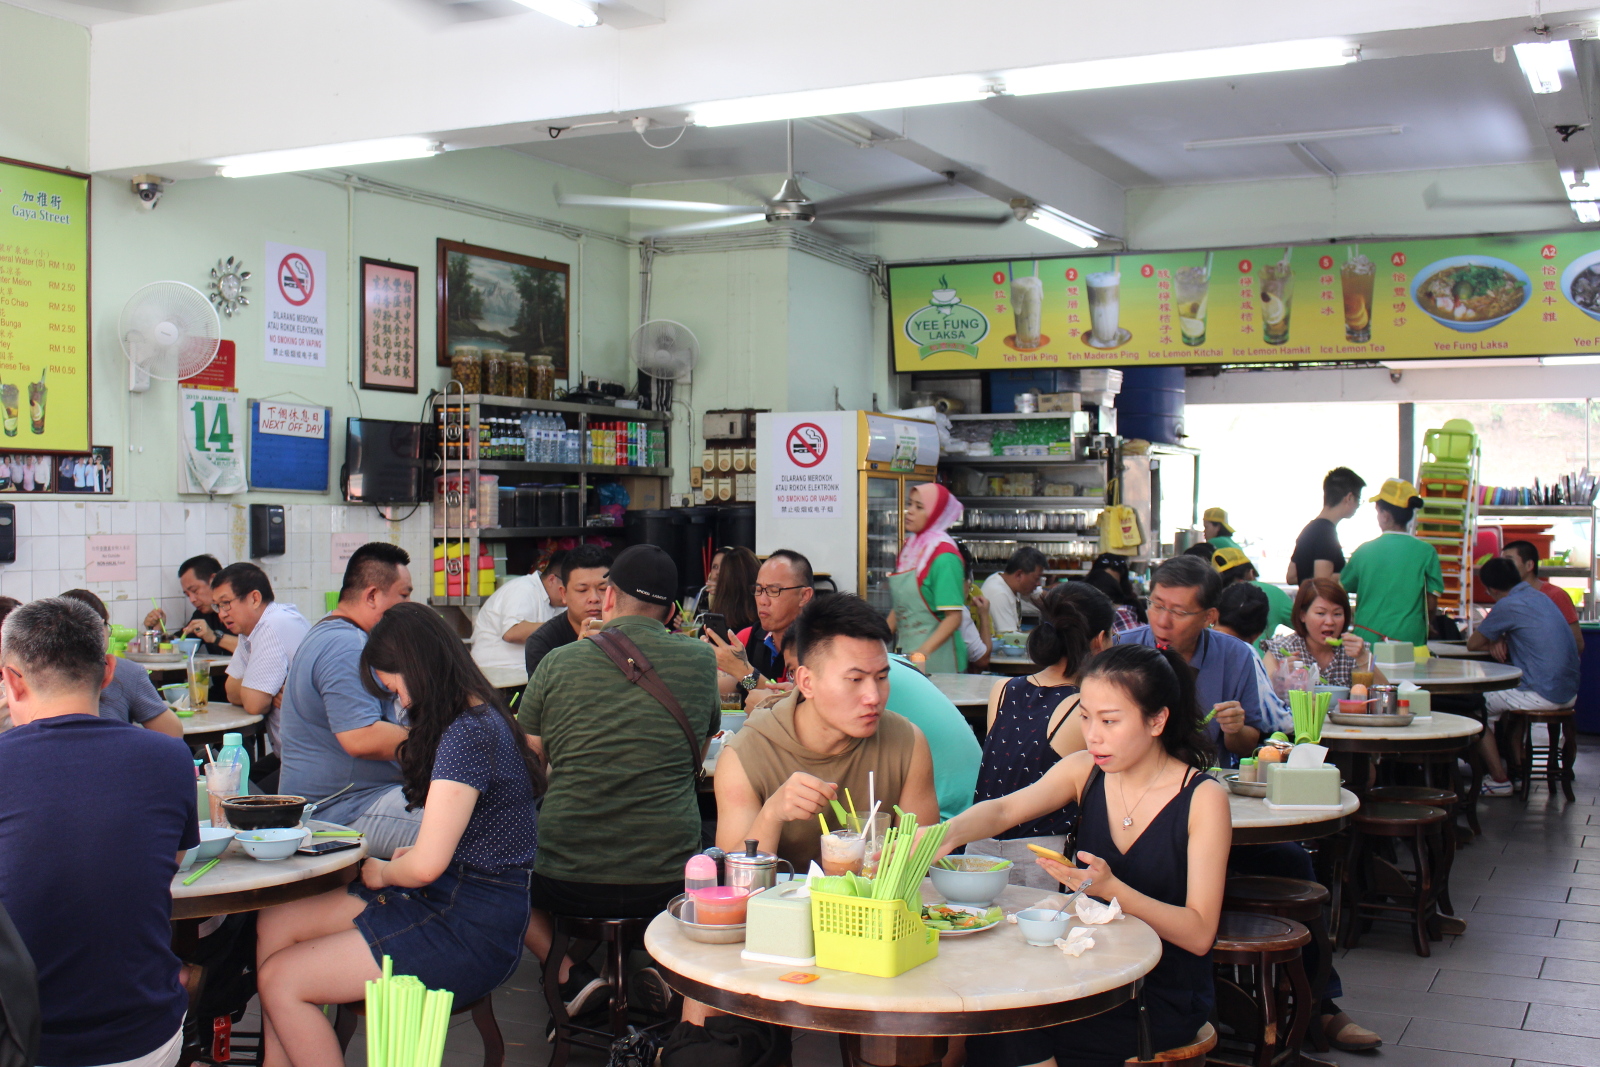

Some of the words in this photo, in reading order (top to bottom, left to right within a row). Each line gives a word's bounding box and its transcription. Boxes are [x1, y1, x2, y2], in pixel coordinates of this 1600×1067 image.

[22, 190, 62, 210] 加雅街
[12, 204, 37, 221] Gaya
[39, 209, 70, 225] Street
[1542, 247, 1557, 258] A2
[15, 256, 34, 266] Water
[48, 260, 60, 269] RM
[62, 262, 76, 272] 1.00
[1393, 255, 1405, 264] A1
[12, 276, 32, 287] Melon
[48, 281, 60, 290] RM
[61, 283, 76, 292] 2.50
[1, 296, 10, 305] Fo
[11, 297, 29, 307] Chao
[48, 302, 60, 311] RM
[61, 303, 76, 313] 2.50
[273, 310, 296, 322] DILARANG
[296, 314, 319, 325] MEROKOK
[0, 318, 22, 330] Bunga
[48, 322, 60, 332] RM
[61, 324, 76, 334] 2.50
[267, 321, 280, 331] ATAU
[280, 323, 296, 333] ROKOK
[296, 325, 324, 336] ELEKTRONIK
[914, 320, 940, 331] YEE
[944, 318, 979, 330] FUNG
[929, 330, 966, 340] LAKSA
[269, 334, 276, 343] NO
[277, 335, 297, 346] SMOKING
[298, 338, 305, 346] OR
[306, 339, 322, 349] VAPING
[1434, 341, 1451, 350] Yee
[1453, 341, 1478, 352] Fung
[1480, 340, 1509, 350] Laksa
[1573, 337, 1592, 347] Yee
[49, 344, 60, 352] RM
[62, 345, 76, 354] 1.50
[1148, 350, 1162, 359] Ice
[1163, 349, 1192, 359] Lemon
[1193, 347, 1224, 357] Kitchai
[1232, 347, 1246, 356] Ice
[1247, 346, 1278, 356] Lemon
[1280, 345, 1311, 355] Hamkit
[1320, 345, 1334, 354] Ice
[1336, 344, 1367, 353] Lemon
[1369, 343, 1386, 353] Tea
[1003, 353, 1018, 362] Teh
[1019, 353, 1038, 362] Tarik
[1040, 351, 1058, 363] Ping
[1067, 352, 1082, 361] Teh
[1084, 351, 1118, 360] Maderas
[1120, 350, 1140, 362] Ping
[18, 362, 31, 372] Tea
[49, 365, 60, 374] RM
[62, 366, 76, 375] 0.50
[190, 401, 234, 453] 14
[262, 419, 287, 430] NEXT
[288, 422, 304, 432] OFF
[305, 423, 323, 434] DAY
[807, 474, 833, 482] MEROKOK
[808, 483, 840, 491] ELEKTRONIK
[818, 494, 838, 502] VAPING
